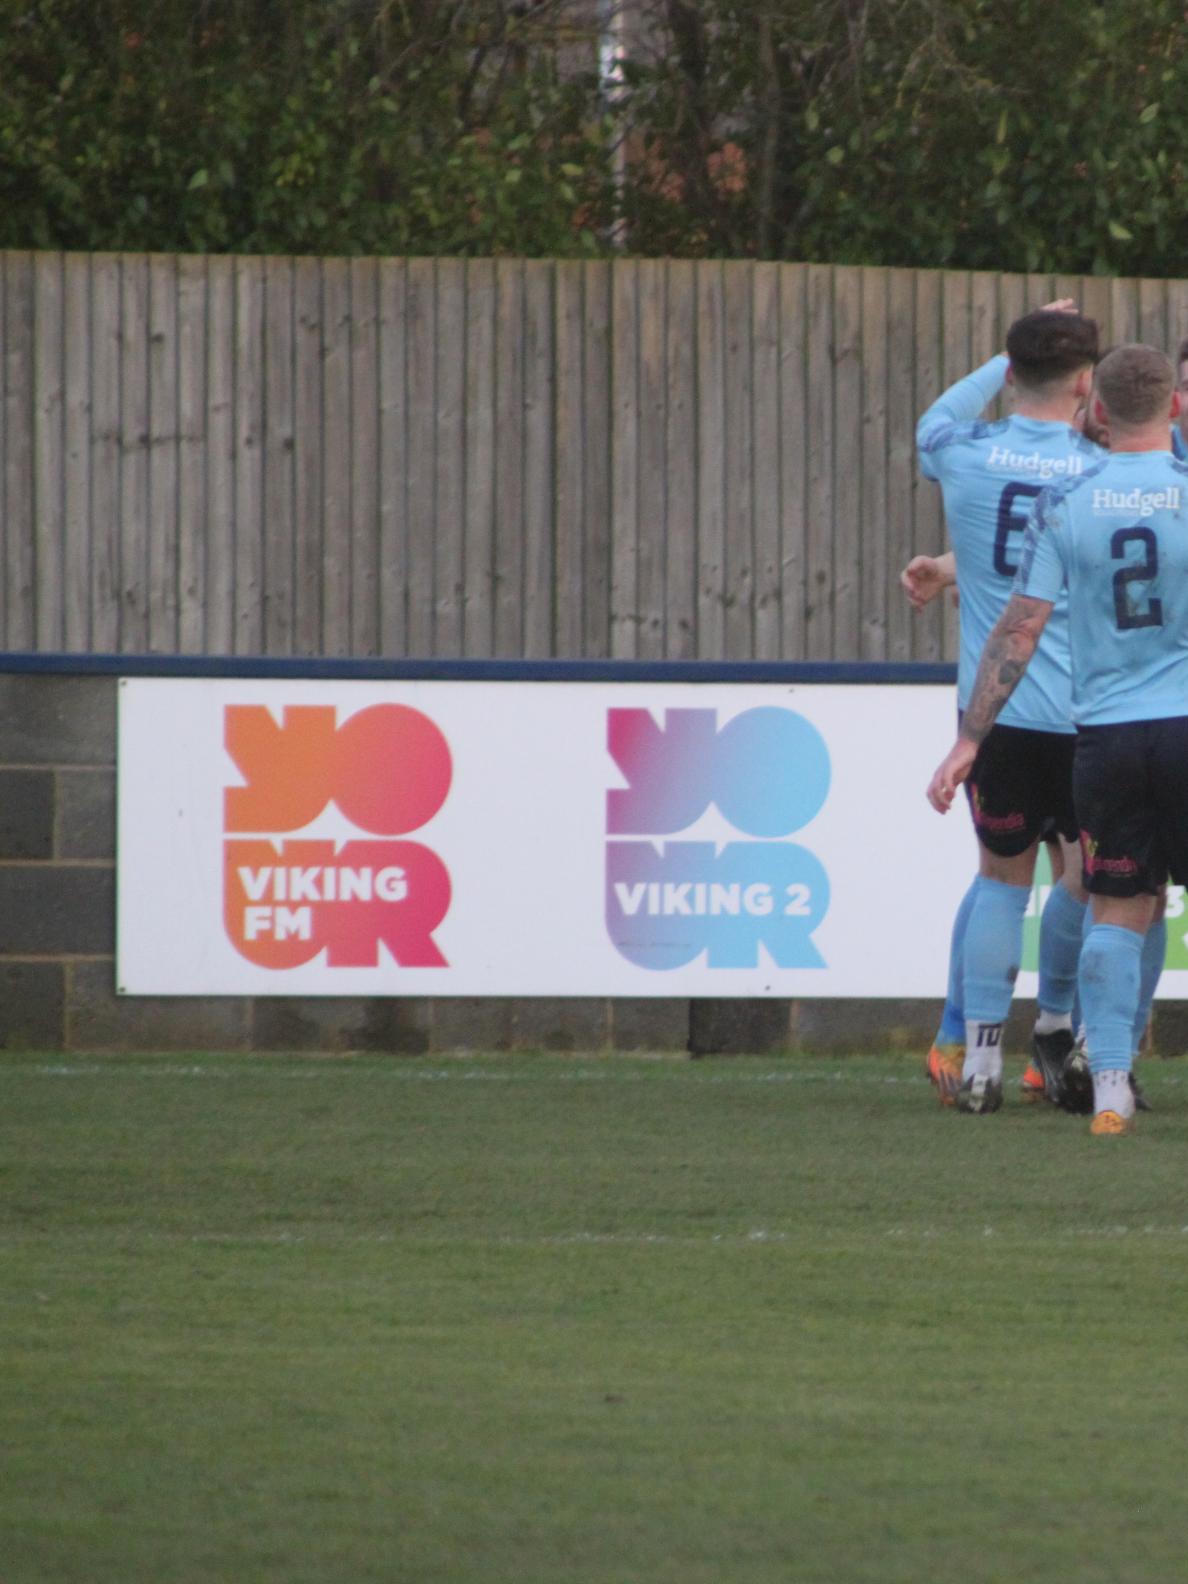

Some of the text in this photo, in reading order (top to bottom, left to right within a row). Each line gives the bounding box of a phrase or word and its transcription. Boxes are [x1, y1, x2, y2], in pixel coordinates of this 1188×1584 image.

[987, 445, 1083, 479] Hudgell
[1092, 486, 1180, 516] Hudgell
[1110, 526, 1163, 630] 2
[238, 866, 408, 902] VIKING
[615, 882, 811, 915] VIKING 2
[244, 907, 312, 940] FM
